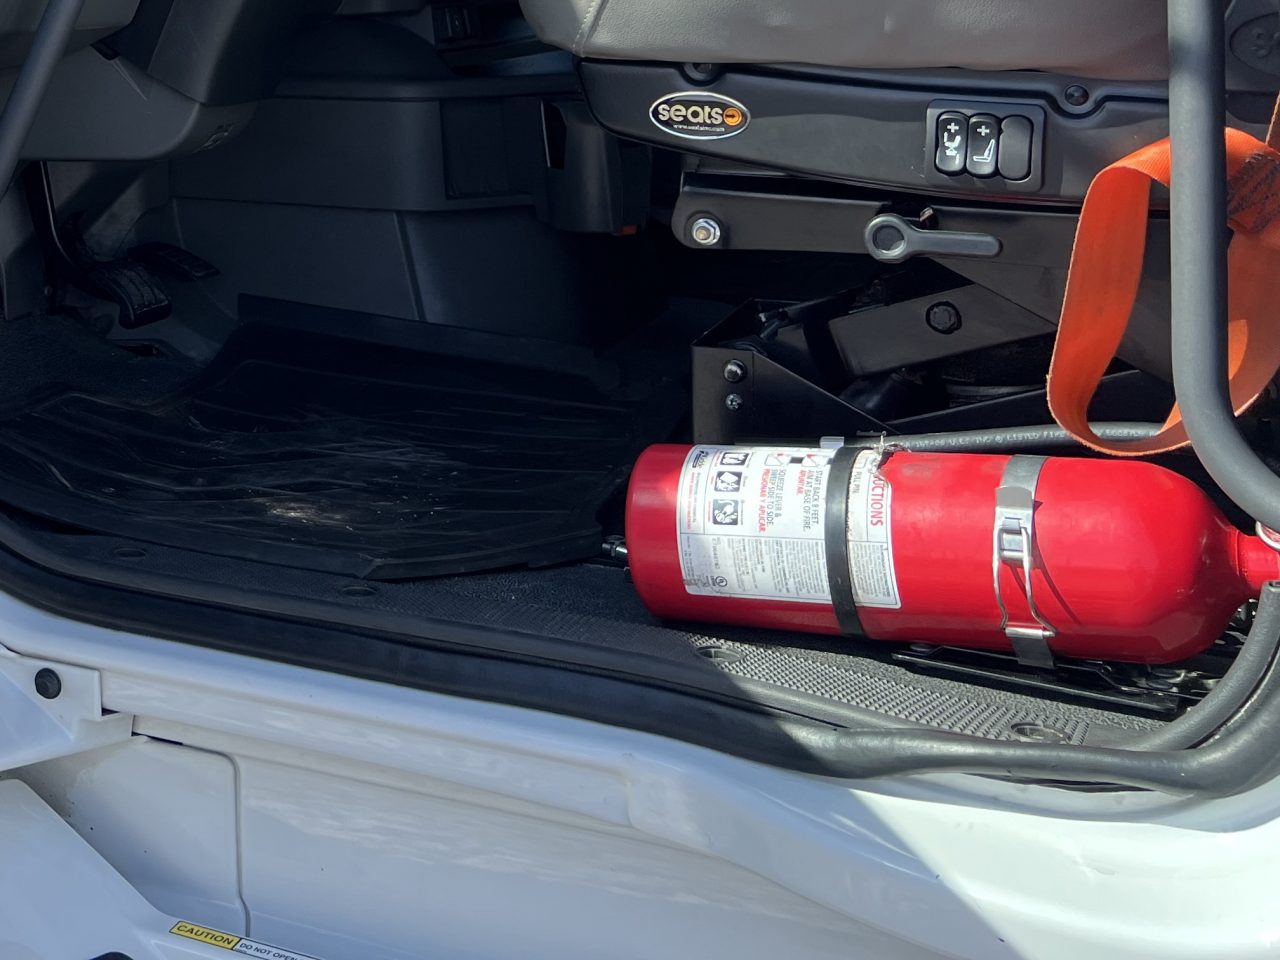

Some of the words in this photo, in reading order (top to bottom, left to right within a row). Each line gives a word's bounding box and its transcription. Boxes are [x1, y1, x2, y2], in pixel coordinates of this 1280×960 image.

[658, 104, 723, 124] seats
[760, 469, 770, 498] PRESIONAR
[769, 469, 778, 485] SWEEP
[776, 469, 786, 491] SQUEEZE
[814, 470, 822, 485] START
[853, 472, 862, 483] PULL
[812, 487, 820, 502] BACK
[870, 475, 885, 526] UCTIONS
[767, 501, 773, 509] TO
[803, 506, 810, 514] OF
[176, 924, 234, 945] CAUTION
[239, 942, 252, 950] DO
[254, 946, 272, 956] NOT
[272, 952, 298, 960] OPEN
